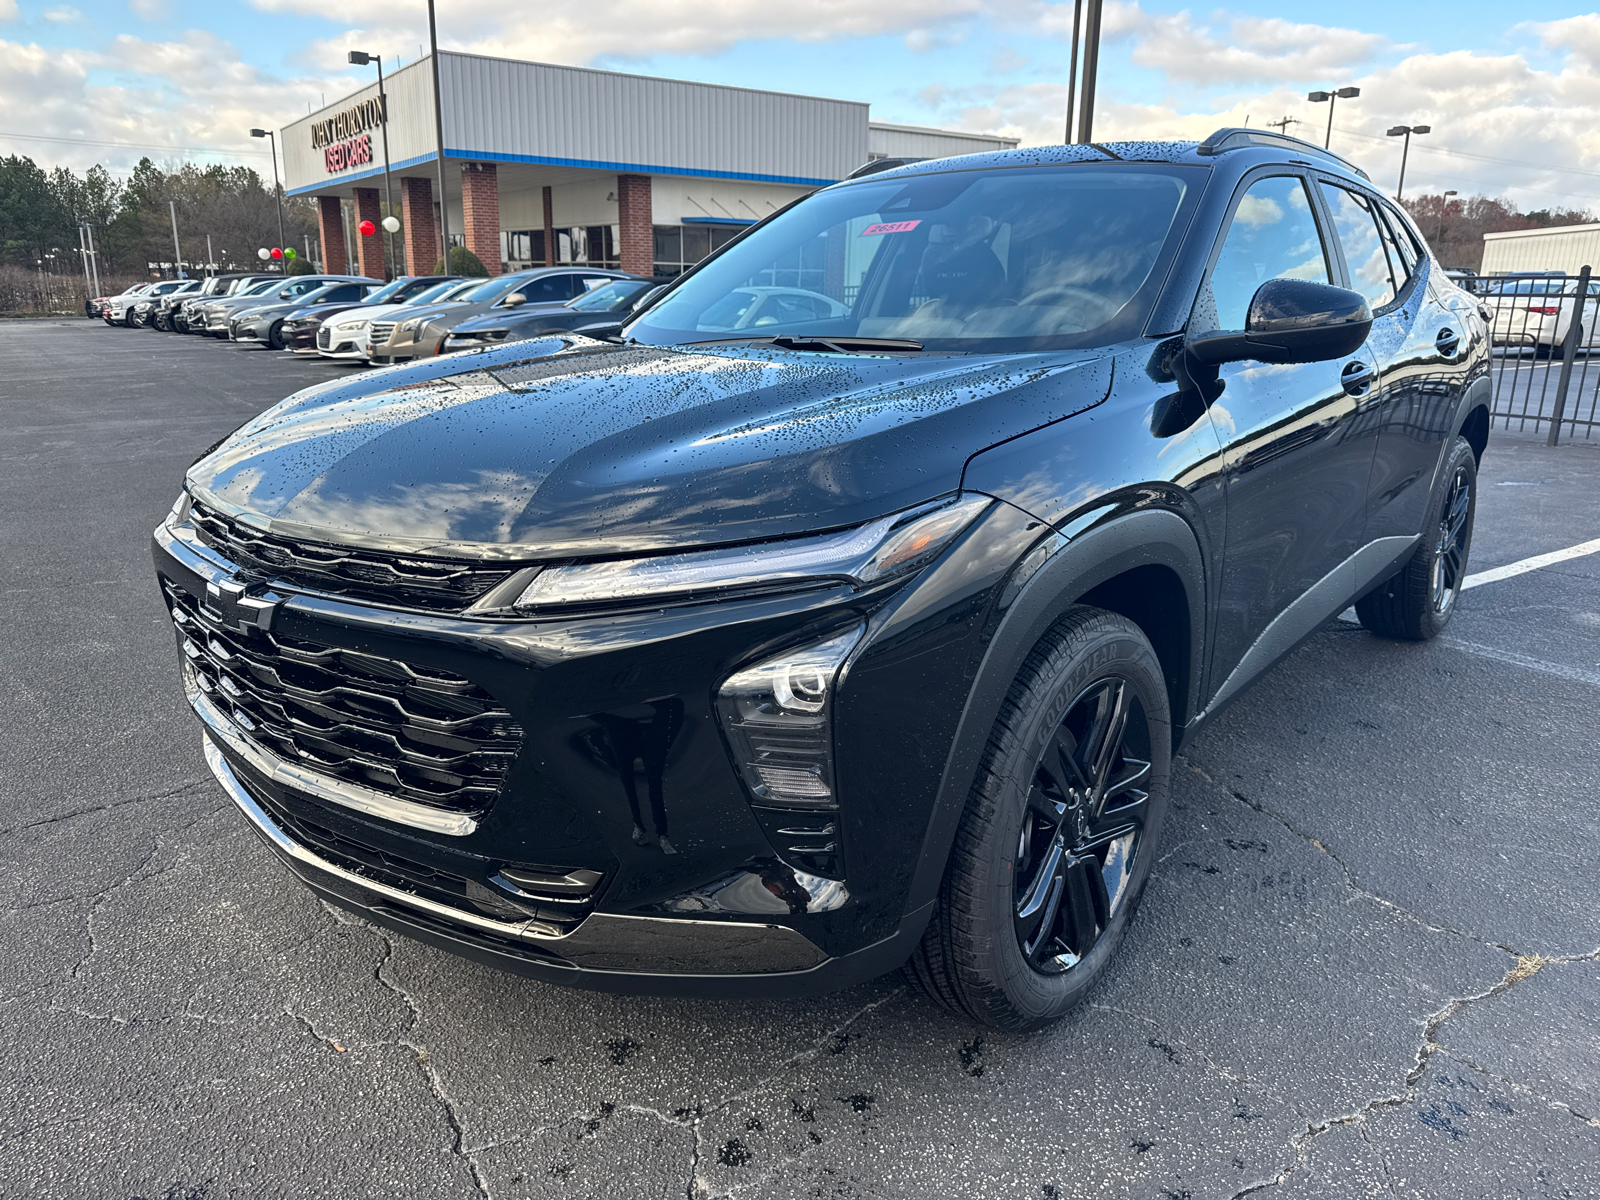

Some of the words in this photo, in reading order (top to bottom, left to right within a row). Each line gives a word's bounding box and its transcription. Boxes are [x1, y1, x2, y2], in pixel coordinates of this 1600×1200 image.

[310, 118, 333, 149] JOHN
[331, 94, 387, 140] THORNTON
[324, 144, 346, 172] USED
[345, 134, 372, 166] CARS
[869, 222, 911, 233] 26511
[1036, 643, 1118, 746] GOODYEAR
